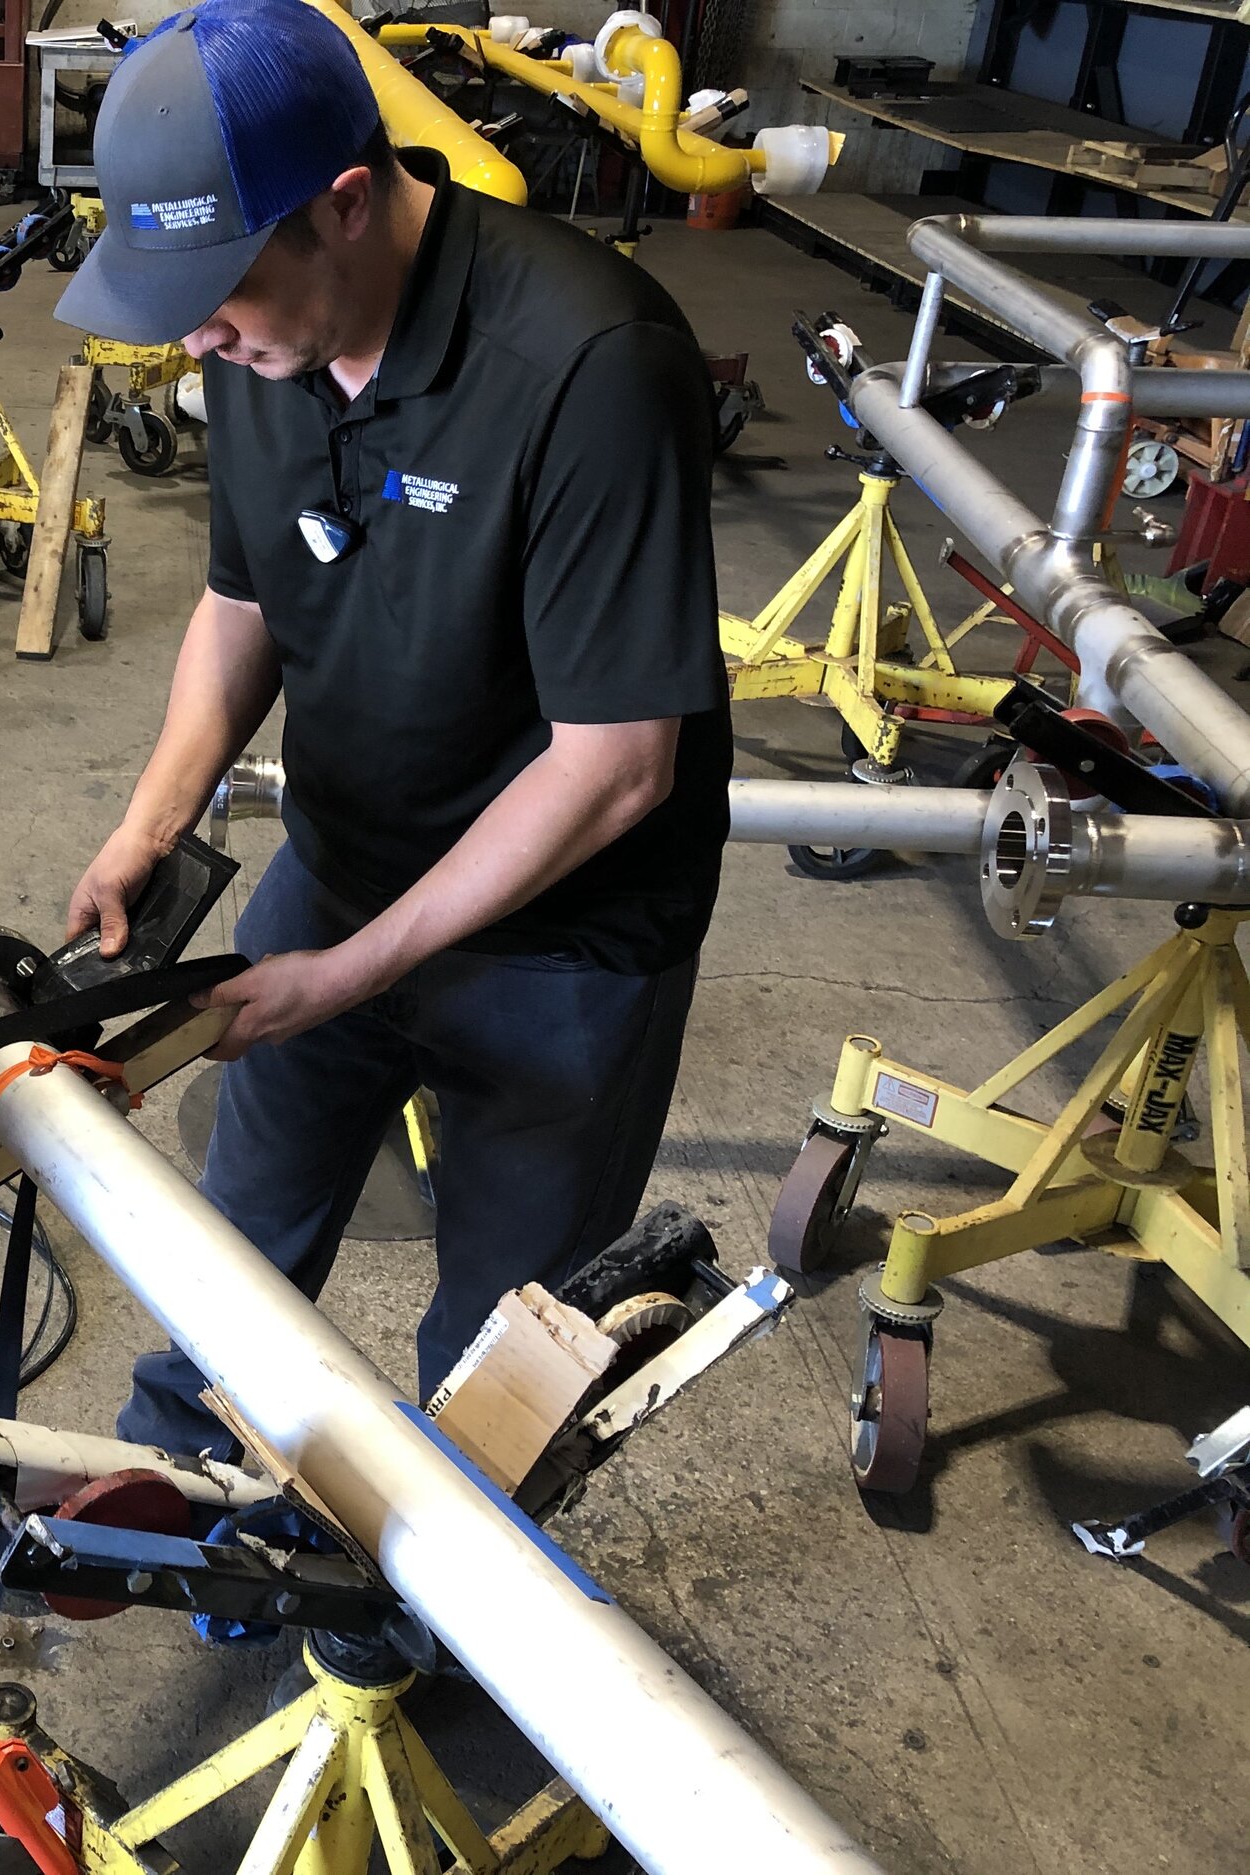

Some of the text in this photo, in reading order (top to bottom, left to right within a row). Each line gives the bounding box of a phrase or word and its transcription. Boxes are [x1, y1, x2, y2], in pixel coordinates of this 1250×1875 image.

[151, 194, 218, 213] METALLURGICAL
[159, 205, 215, 222] ENGINEERING
[401, 473, 459, 494] METALLURGICAL
[404, 485, 454, 504] ENGINEERING
[1136, 1031, 1200, 1135] MAX-JAX
